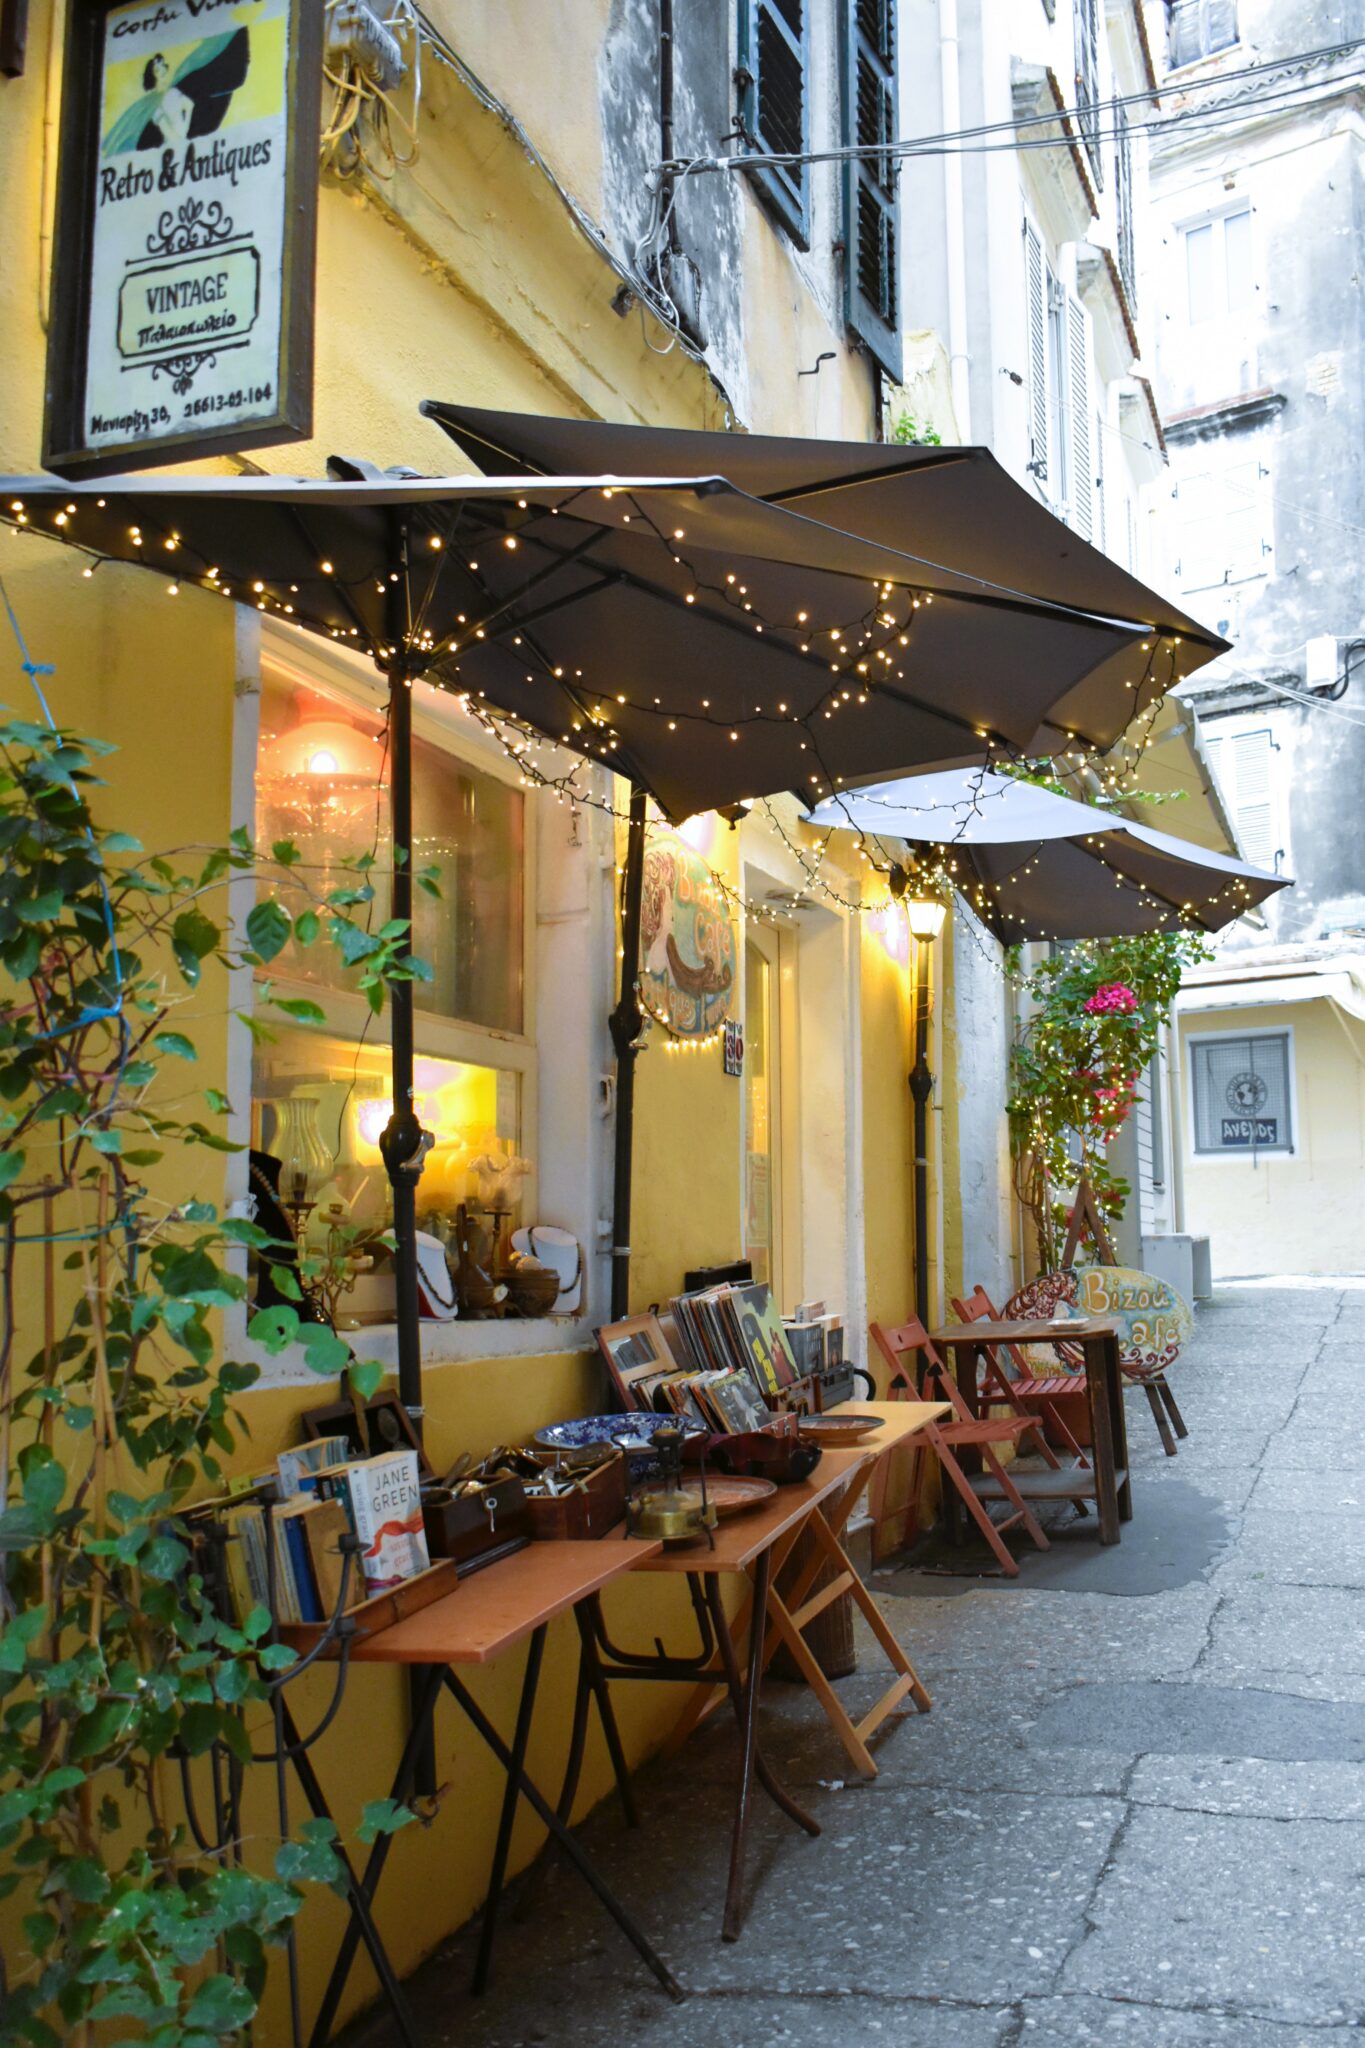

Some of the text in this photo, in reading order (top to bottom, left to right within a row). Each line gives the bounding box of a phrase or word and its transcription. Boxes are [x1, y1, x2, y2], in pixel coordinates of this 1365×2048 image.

[100, 139, 272, 206] Retro & Antiques
[146, 272, 229, 315] VINTAGE
[374, 1465, 410, 1492] JANE
[372, 1484, 418, 1513] GREEN
